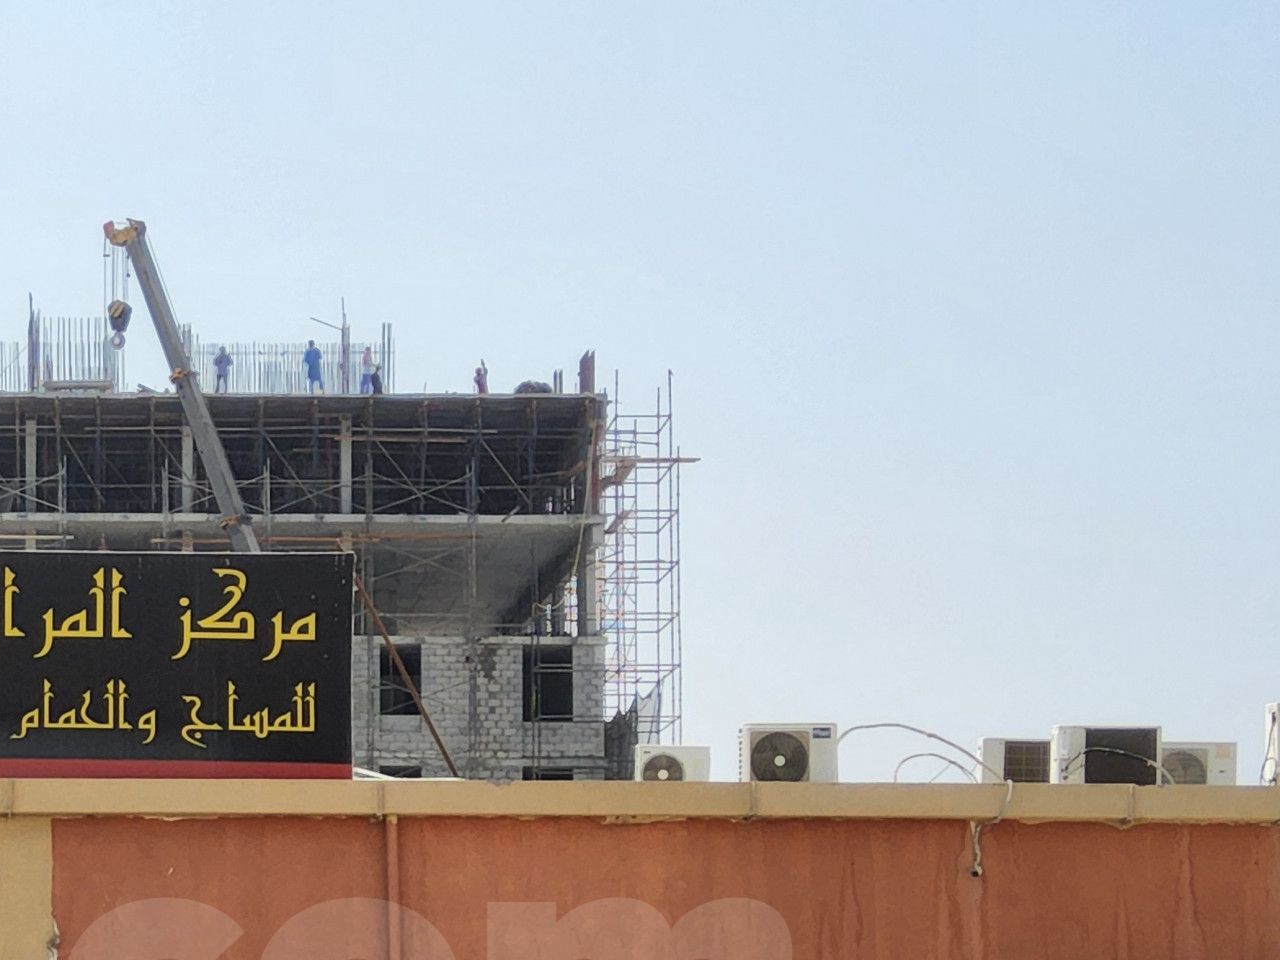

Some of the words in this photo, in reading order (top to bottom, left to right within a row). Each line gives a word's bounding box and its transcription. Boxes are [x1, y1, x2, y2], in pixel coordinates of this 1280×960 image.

[171, 566, 317, 662] مركز
[10, 677, 157, 745] والحمام
[180, 681, 317, 749] للمساج
